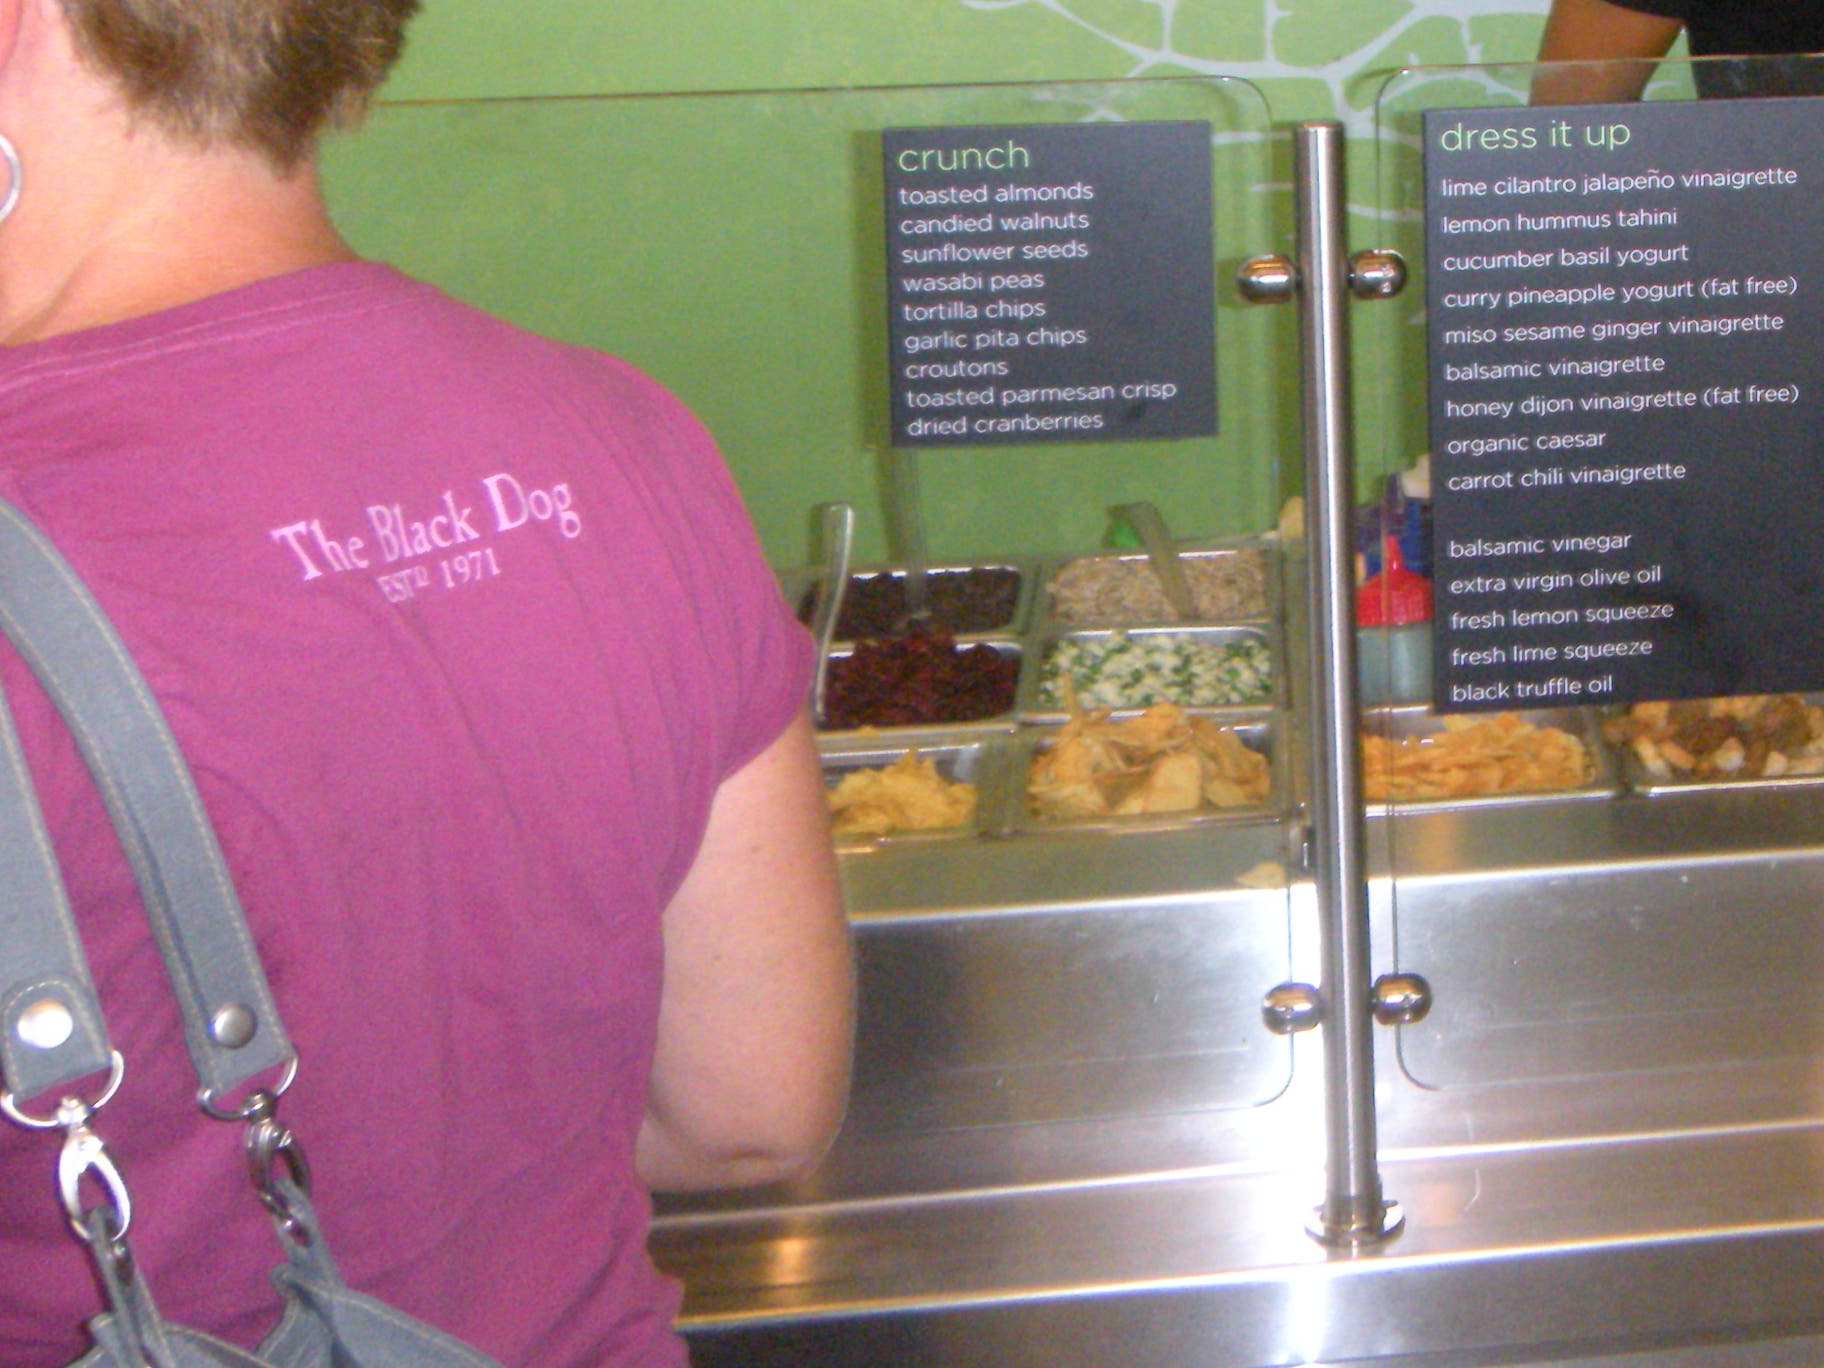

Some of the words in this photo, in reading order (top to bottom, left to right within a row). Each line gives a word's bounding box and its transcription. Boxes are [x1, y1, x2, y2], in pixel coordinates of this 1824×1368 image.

[1440, 122, 1537, 151] dress
[1550, 120, 1572, 148] it
[1585, 122, 1631, 151] up
[899, 140, 1030, 172] crunch
[899, 184, 988, 205] toasted
[995, 182, 1094, 203] almonds
[1441, 178, 1487, 197] lime
[1494, 176, 1577, 196] cilantro
[1581, 169, 1675, 195] jalapeño
[1682, 167, 1798, 189] vinaigrette
[900, 214, 993, 234] candied
[1000, 212, 1090, 231] walnuts
[1442, 215, 1510, 234] lemon
[1516, 212, 1612, 231] hummus
[1618, 208, 1678, 227] tahini
[901, 243, 1015, 264] sunflower
[1021, 240, 1089, 261] seeds
[1443, 250, 1553, 271] cucumber
[1560, 246, 1610, 266] basil
[1616, 244, 1689, 268] yogurt
[902, 272, 983, 292] wasabi
[990, 272, 1045, 293] peas
[1444, 290, 1501, 309] curry
[1507, 284, 1615, 307] pineapple
[1622, 280, 1694, 305] yogurt
[1701, 278, 1739, 299] (fat
[1746, 275, 1798, 296] free)
[903, 301, 978, 322] tortilla
[985, 300, 1046, 321] chips
[904, 330, 968, 354] garlic
[975, 329, 1019, 351] pita
[1026, 327, 1088, 348] chips
[1445, 326, 1497, 345] miso
[1503, 323, 1585, 342] sesame
[1591, 319, 1661, 342] ginger
[1668, 313, 1784, 335] vinaigrette
[905, 359, 1009, 379] croutons
[1446, 360, 1542, 382] balsamic
[1549, 355, 1665, 378] vinaigrette
[907, 386, 995, 408] toasted
[1002, 385, 1114, 407] parmesan
[1121, 381, 1177, 401] crisp
[1447, 398, 1513, 419] honey
[1521, 395, 1574, 417] dijon
[1580, 390, 1697, 413] vinaigrette
[1703, 388, 1741, 407] (fat
[1748, 384, 1800, 405] free)
[907, 416, 967, 437] dried
[974, 413, 1104, 434] cranberries
[1447, 434, 1529, 457] organic
[1536, 431, 1606, 451] caesar
[1447, 471, 1513, 492] carrot
[1520, 468, 1564, 488] chili
[1570, 464, 1686, 487] vinaigrette
[270, 518, 369, 582] The
[366, 489, 480, 563] Black
[482, 473, 582, 539] Dog
[1449, 538, 1545, 559] balsamic
[1551, 533, 1632, 555] vinegar
[440, 547, 502, 589] 1971
[1450, 576, 1506, 595] extra
[1513, 572, 1573, 592] virgin
[1580, 568, 1631, 588] olive
[1636, 565, 1662, 584] oil
[1451, 611, 1505, 631] fresh
[1512, 608, 1578, 628] lemon
[1585, 602, 1675, 624] squeeze
[1451, 648, 1505, 667] fresh
[1513, 644, 1557, 664] lime
[1564, 639, 1654, 661] squeeze
[1452, 683, 1509, 703] black
[1516, 677, 1582, 699] truffle
[1588, 675, 1613, 695] oil
